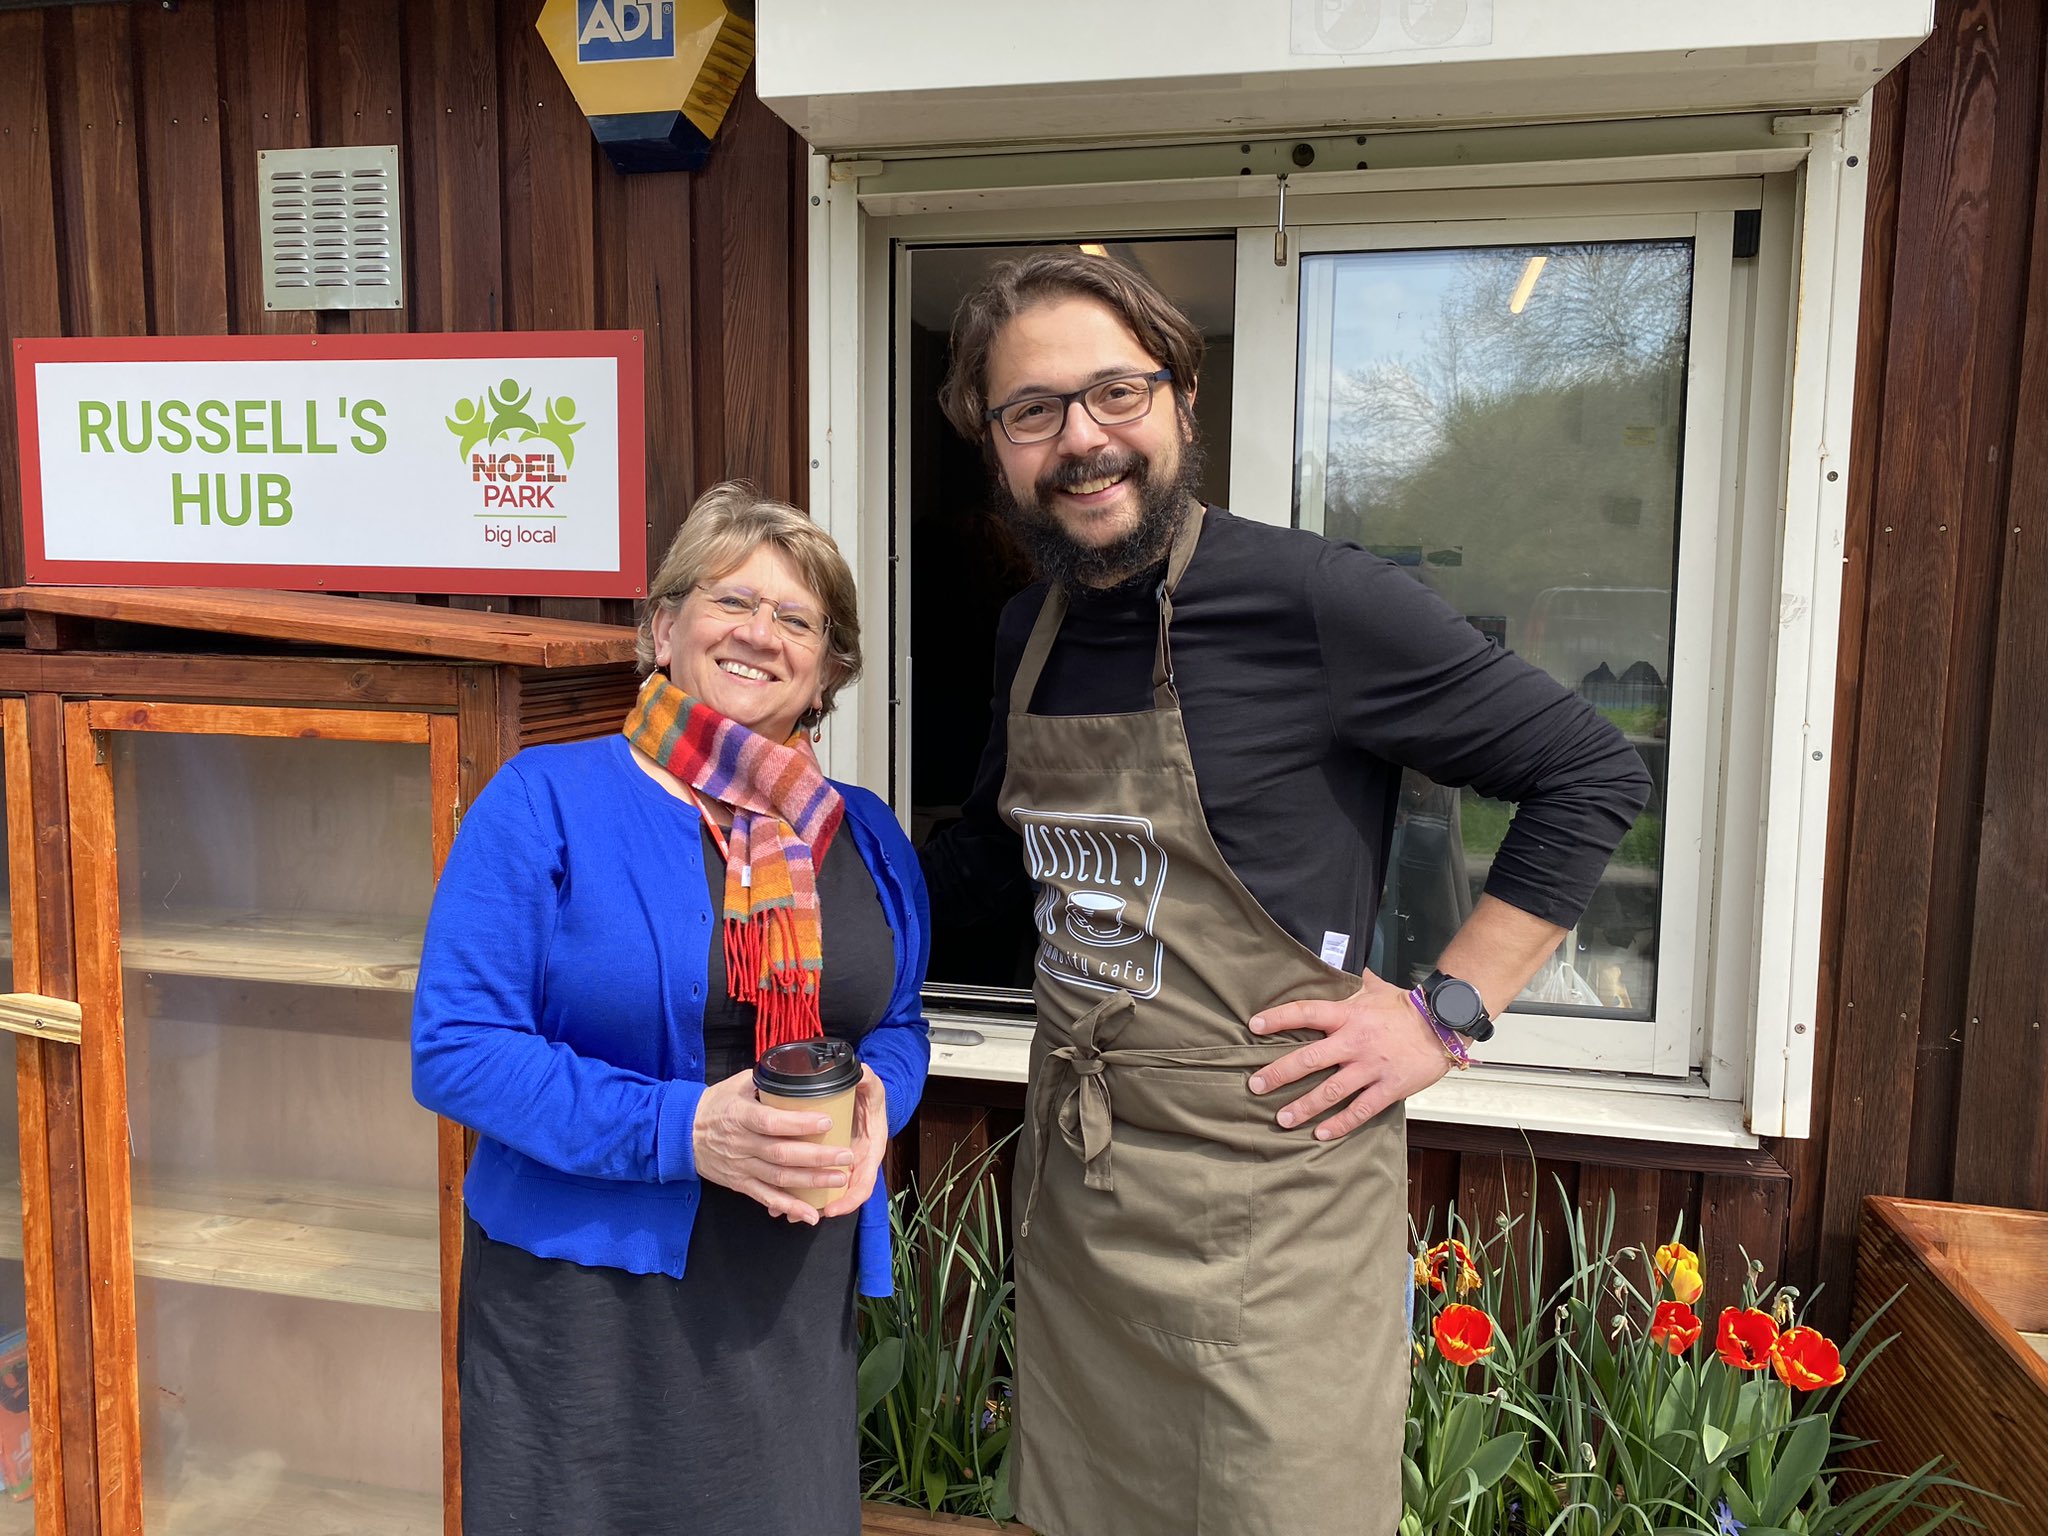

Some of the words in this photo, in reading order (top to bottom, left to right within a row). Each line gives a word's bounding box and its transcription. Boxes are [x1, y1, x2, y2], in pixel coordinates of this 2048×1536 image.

[77, 397, 388, 455] RUSSELL'S
[472, 453, 567, 483] NOEL
[170, 472, 294, 527] HUB
[484, 484, 555, 509] PARK
[484, 524, 512, 548] big
[517, 524, 556, 544] local
[1024, 822, 1147, 887] USSELL'S
[1098, 959, 1145, 982] cafe
